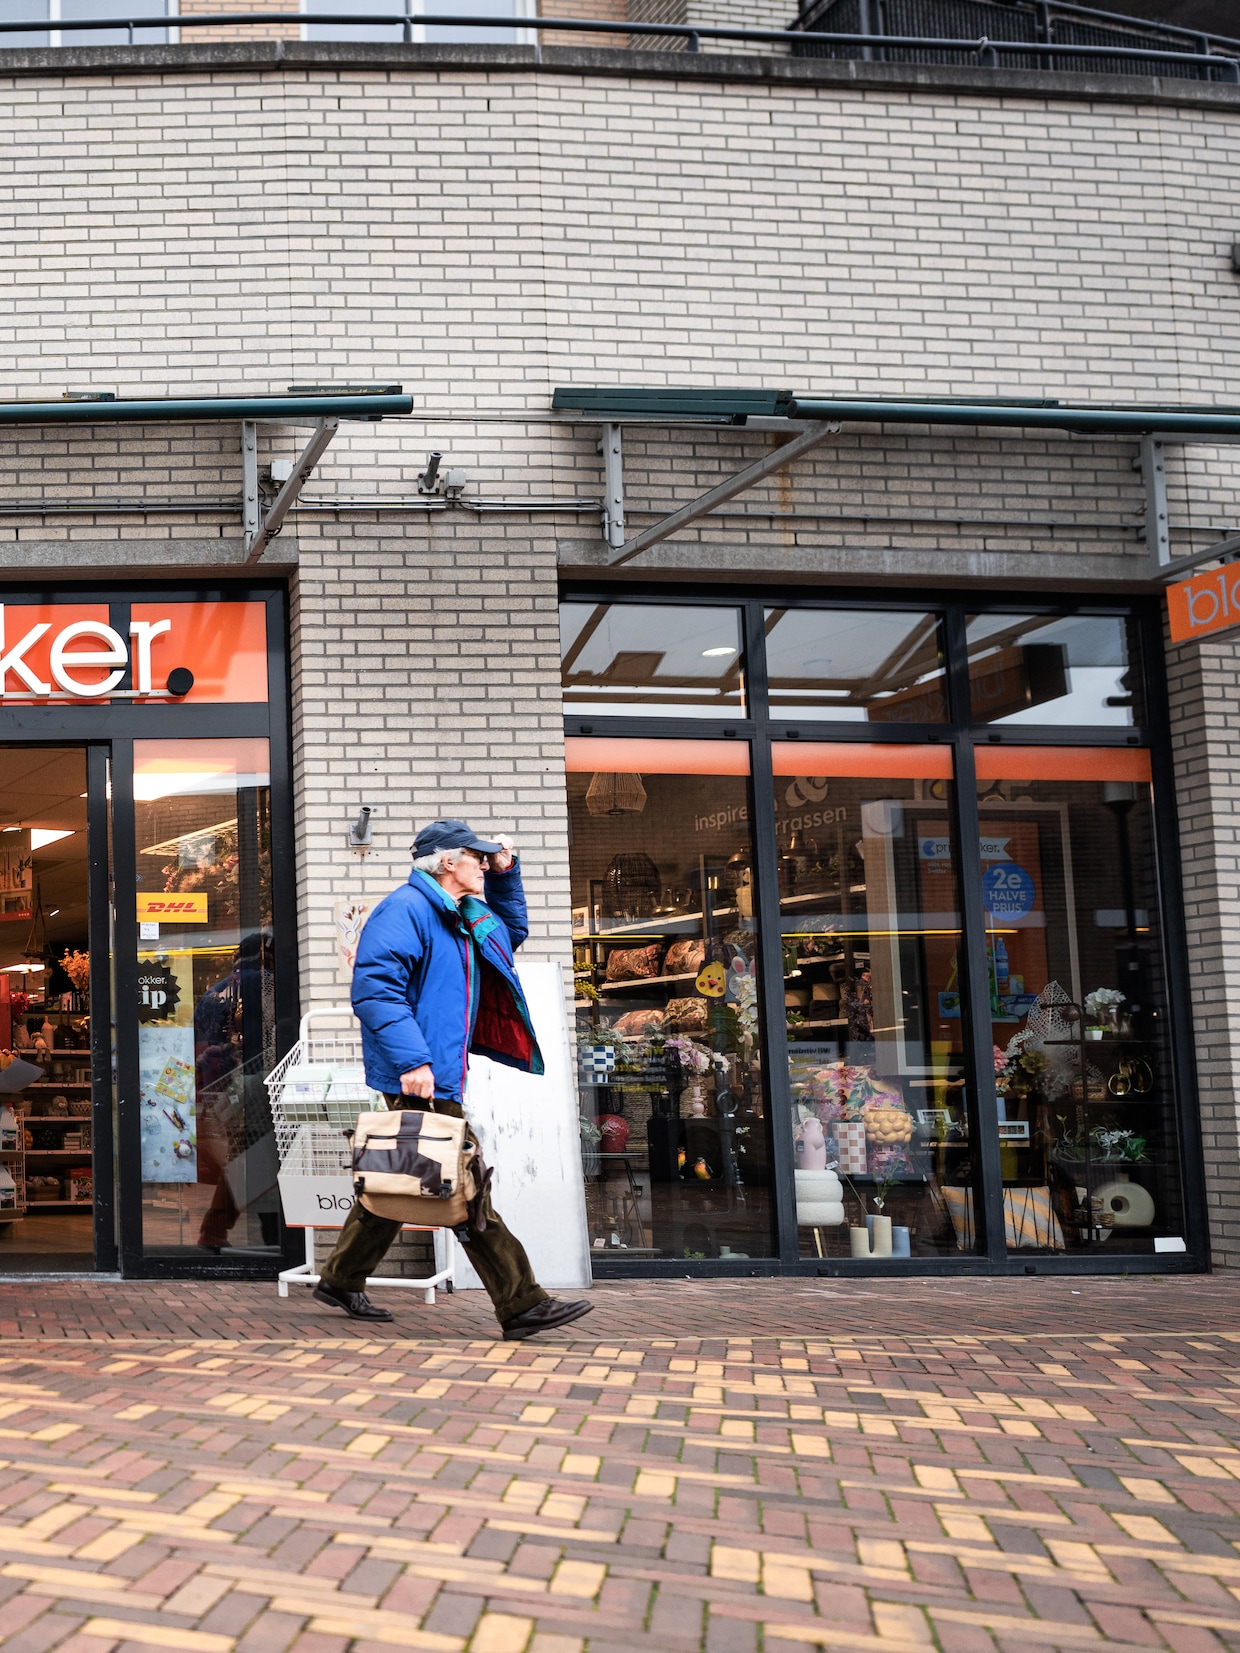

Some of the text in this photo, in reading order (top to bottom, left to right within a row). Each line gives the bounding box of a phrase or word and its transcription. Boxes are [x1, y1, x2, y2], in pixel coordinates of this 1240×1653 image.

[695, 803, 748, 831] inspire
[775, 806, 847, 835] rrassen
[992, 868, 1022, 889] 2e
[989, 891, 1026, 901] HALVE
[146, 902, 198, 913] DHL
[138, 975, 168, 985] okker.
